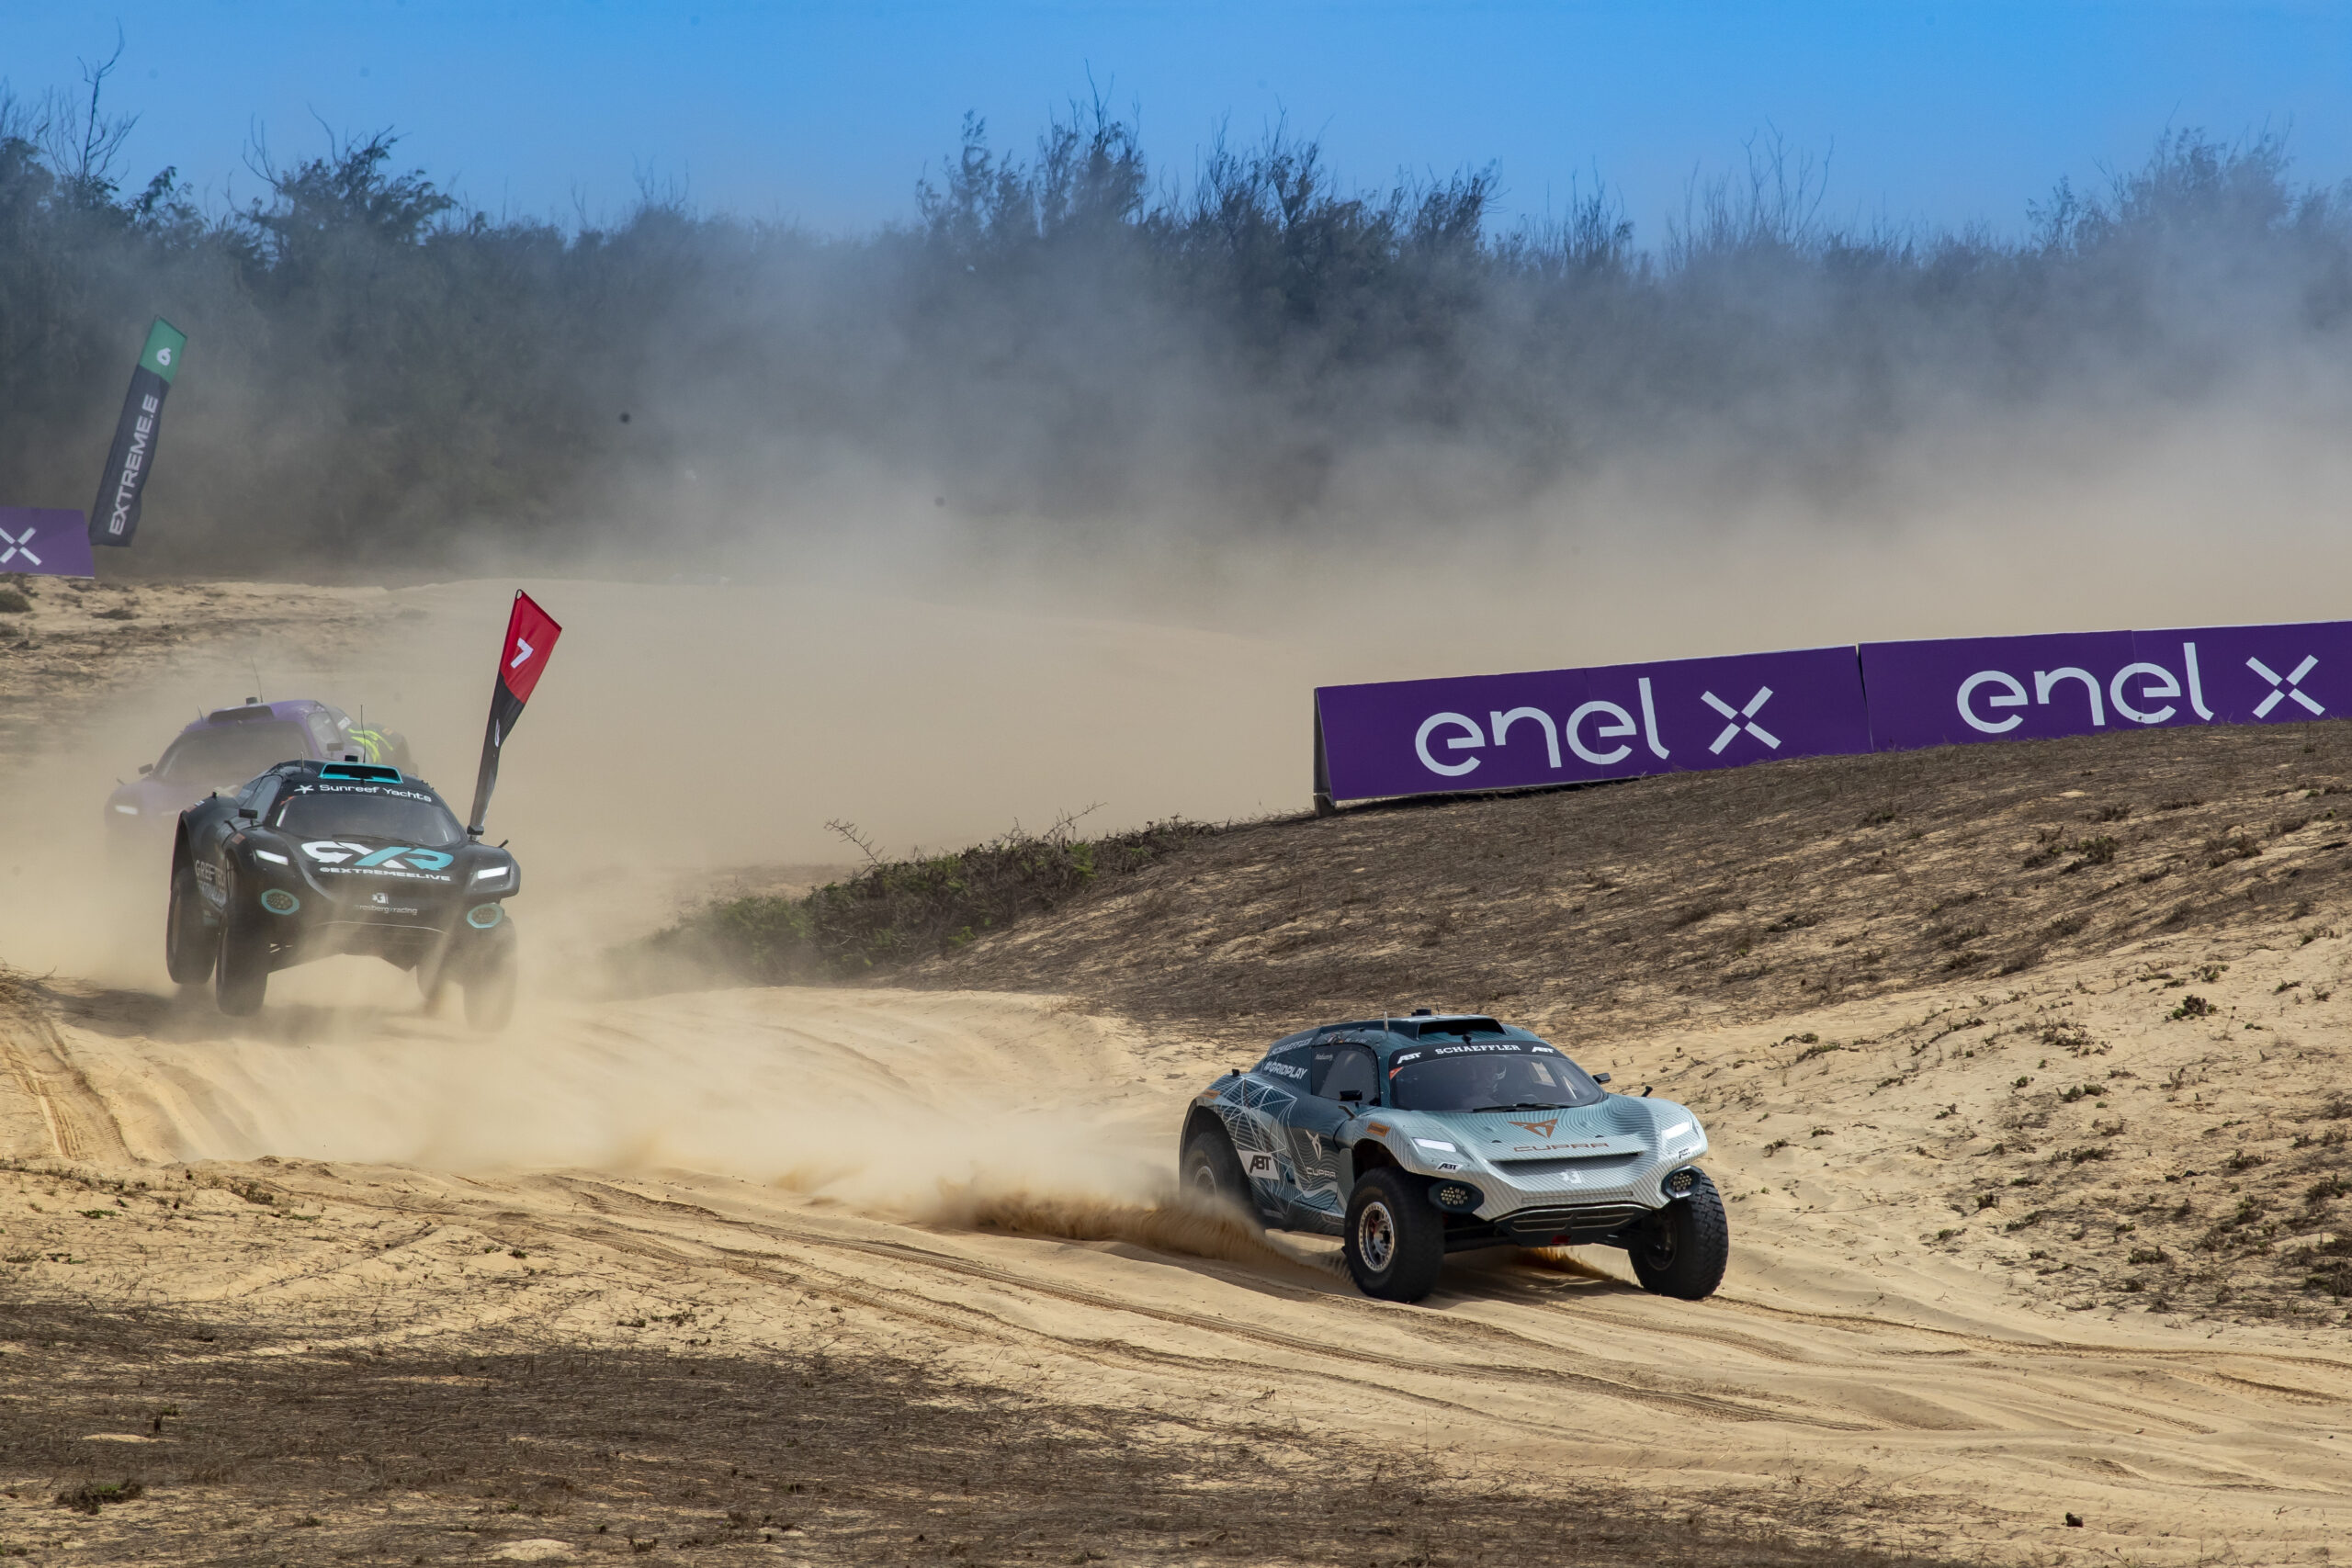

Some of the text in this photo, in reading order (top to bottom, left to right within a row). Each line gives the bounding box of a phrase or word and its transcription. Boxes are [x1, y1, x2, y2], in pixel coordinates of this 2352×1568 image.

[108, 393, 159, 536] EXTREME.E
[510, 637, 534, 669] 7
[1956, 642, 2214, 733] enel
[1415, 677, 1670, 776] enel
[319, 784, 433, 803] Sunreef Yachts
[1396, 1052, 1421, 1064] ABT
[1435, 1044, 1521, 1055] SCHAEFFLER
[1263, 1060, 1308, 1080] #GRIDPLAY
[1514, 1143, 1610, 1152] CUPRA
[1250, 1155, 1272, 1174] ABT
[1306, 1167, 1337, 1179] CUPRA
